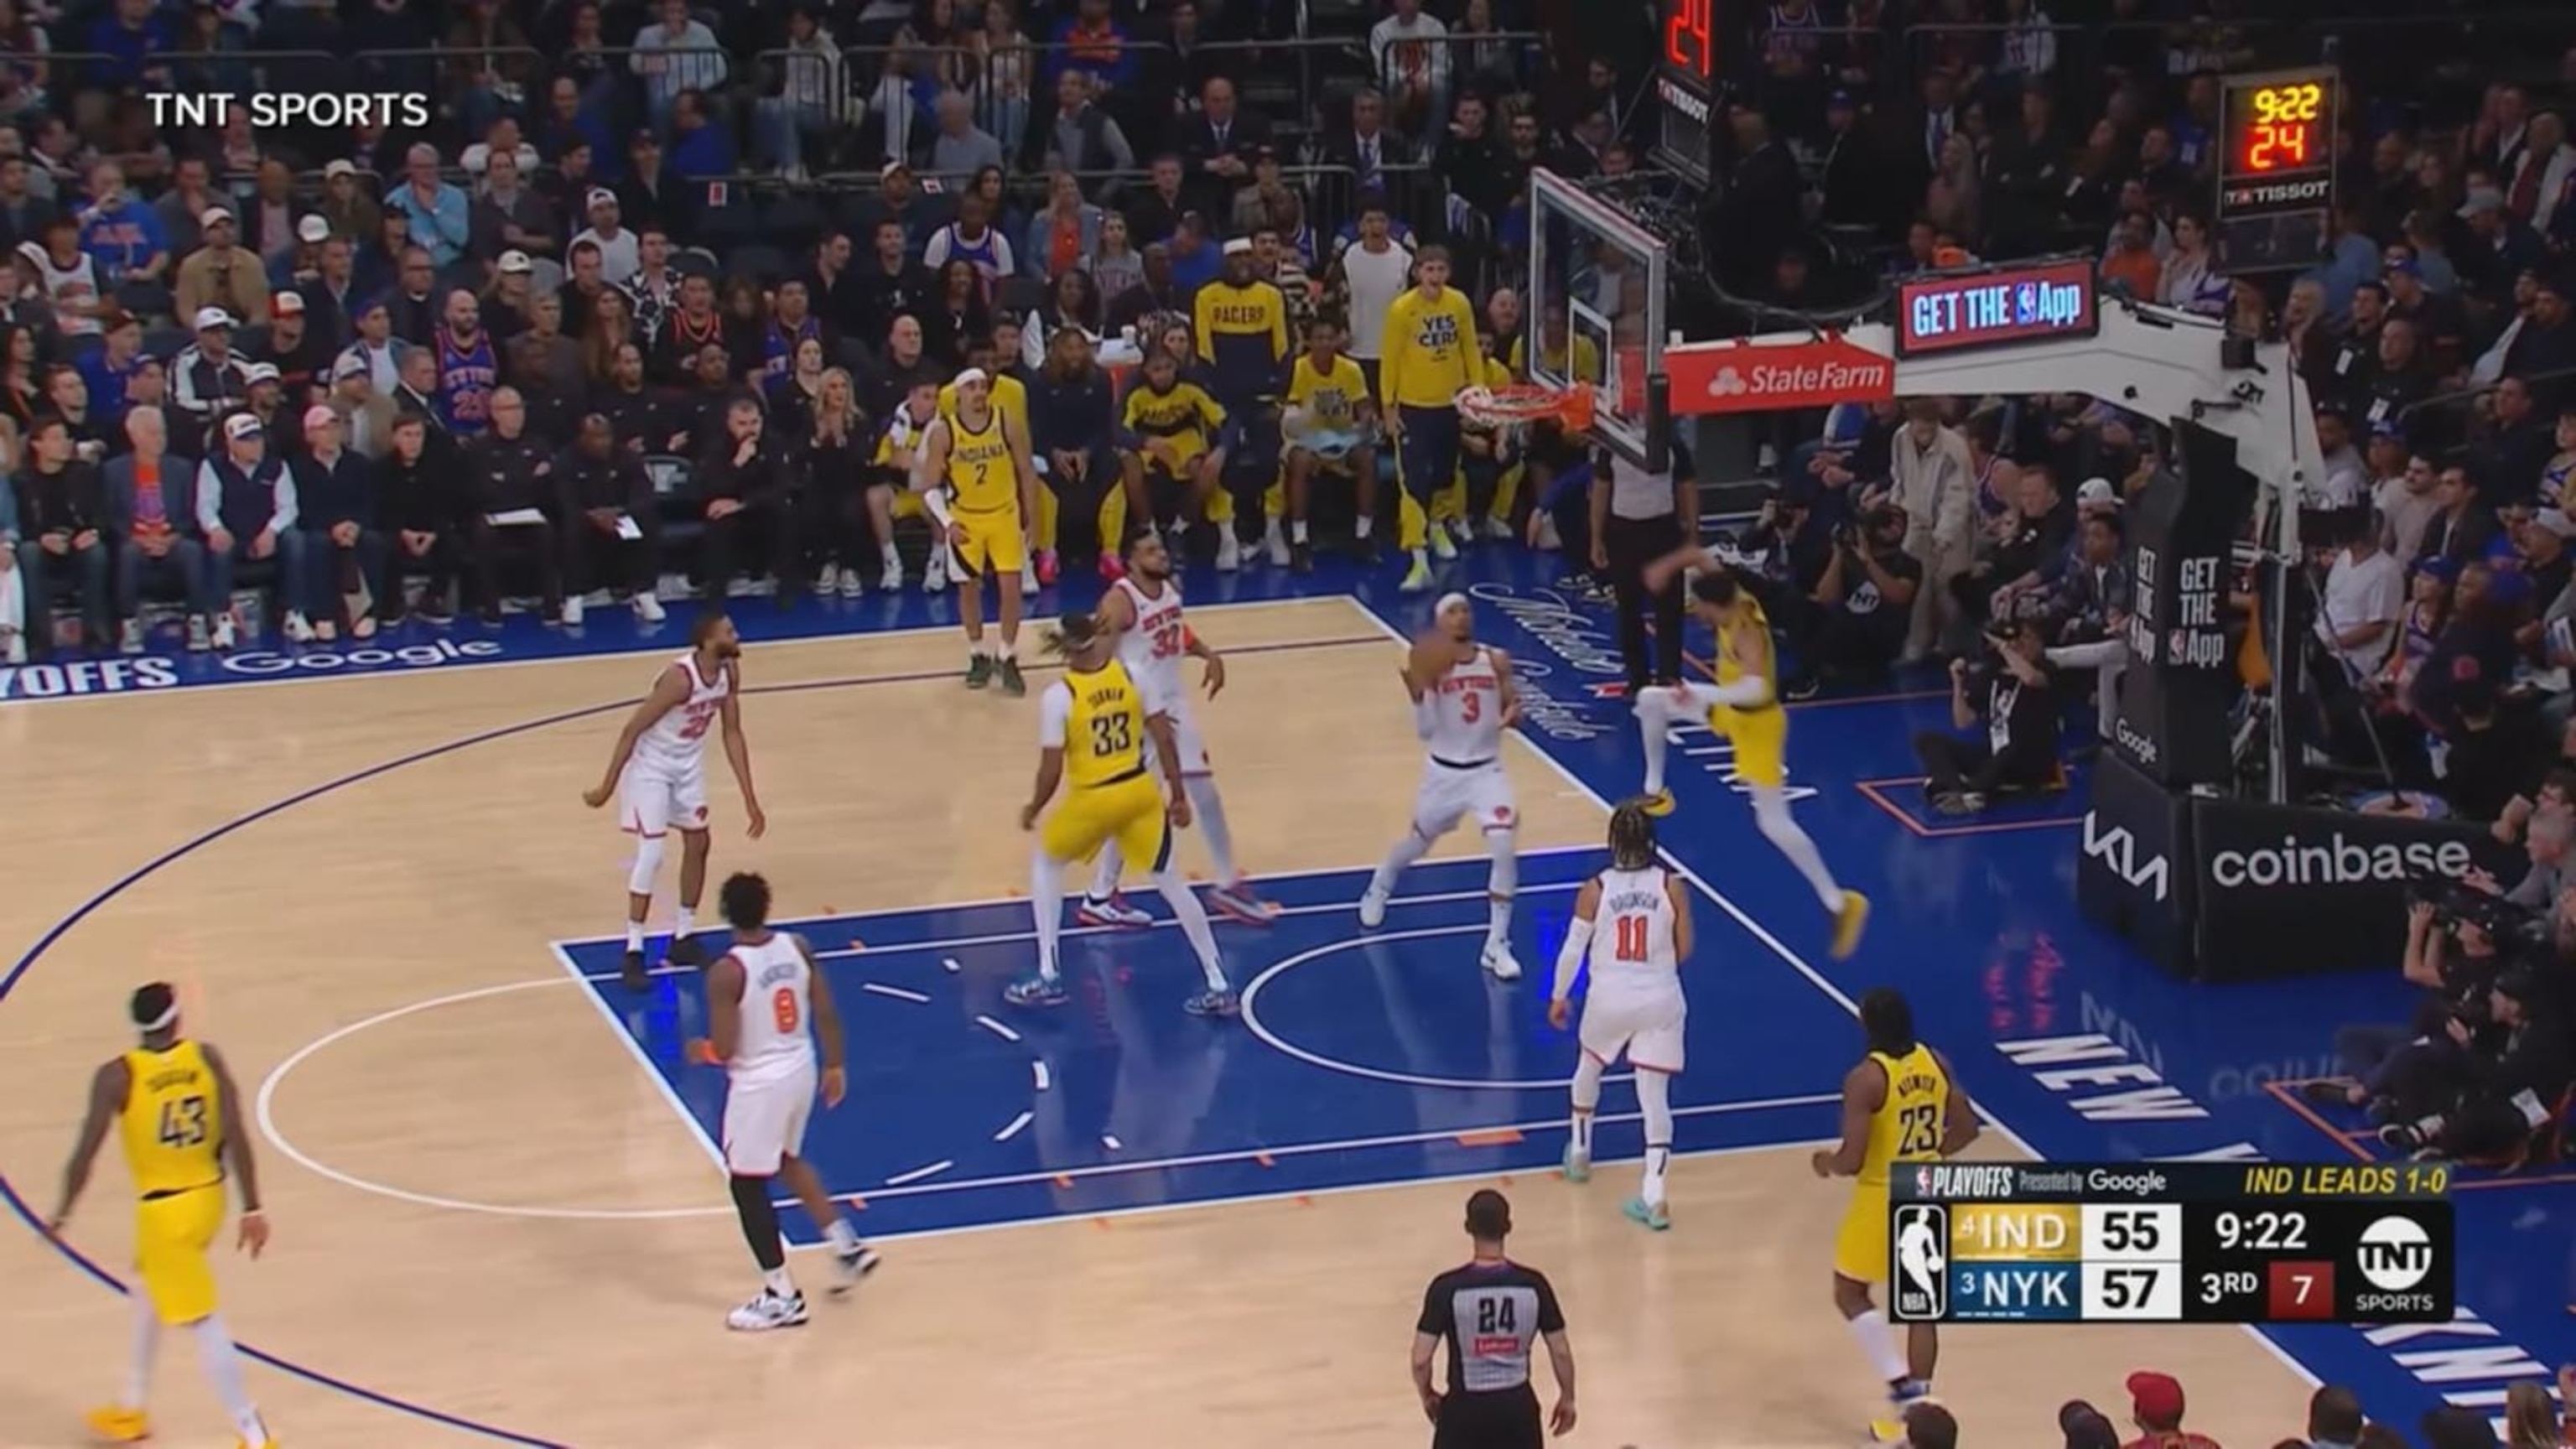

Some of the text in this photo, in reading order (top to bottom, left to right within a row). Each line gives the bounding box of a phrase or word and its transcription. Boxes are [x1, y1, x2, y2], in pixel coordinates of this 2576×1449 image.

[2255, 85, 2320, 123] 9:22
[2250, 125, 2304, 168] 24
[2253, 180, 2329, 203] TISSOT
[1422, 314, 1456, 331] YES
[1913, 281, 2081, 336] GET THE App
[975, 463, 988, 486] 2
[2180, 557, 2220, 592] GET
[2179, 592, 2218, 627] THE
[222, 636, 502, 673] Google
[1151, 622, 1181, 660] 32
[2186, 627, 2225, 668] App
[1462, 691, 1480, 724] 3
[1092, 709, 1131, 757] 33
[2116, 717, 2157, 763] Google
[2211, 832, 2471, 887] coinbase
[1615, 914, 1649, 963] 11
[772, 986, 800, 1036] 8
[1994, 1032, 2214, 1122] NEW
[159, 1094, 207, 1148] 43
[1898, 1103, 1937, 1157] 23
[1478, 1296, 1517, 1334] 24
